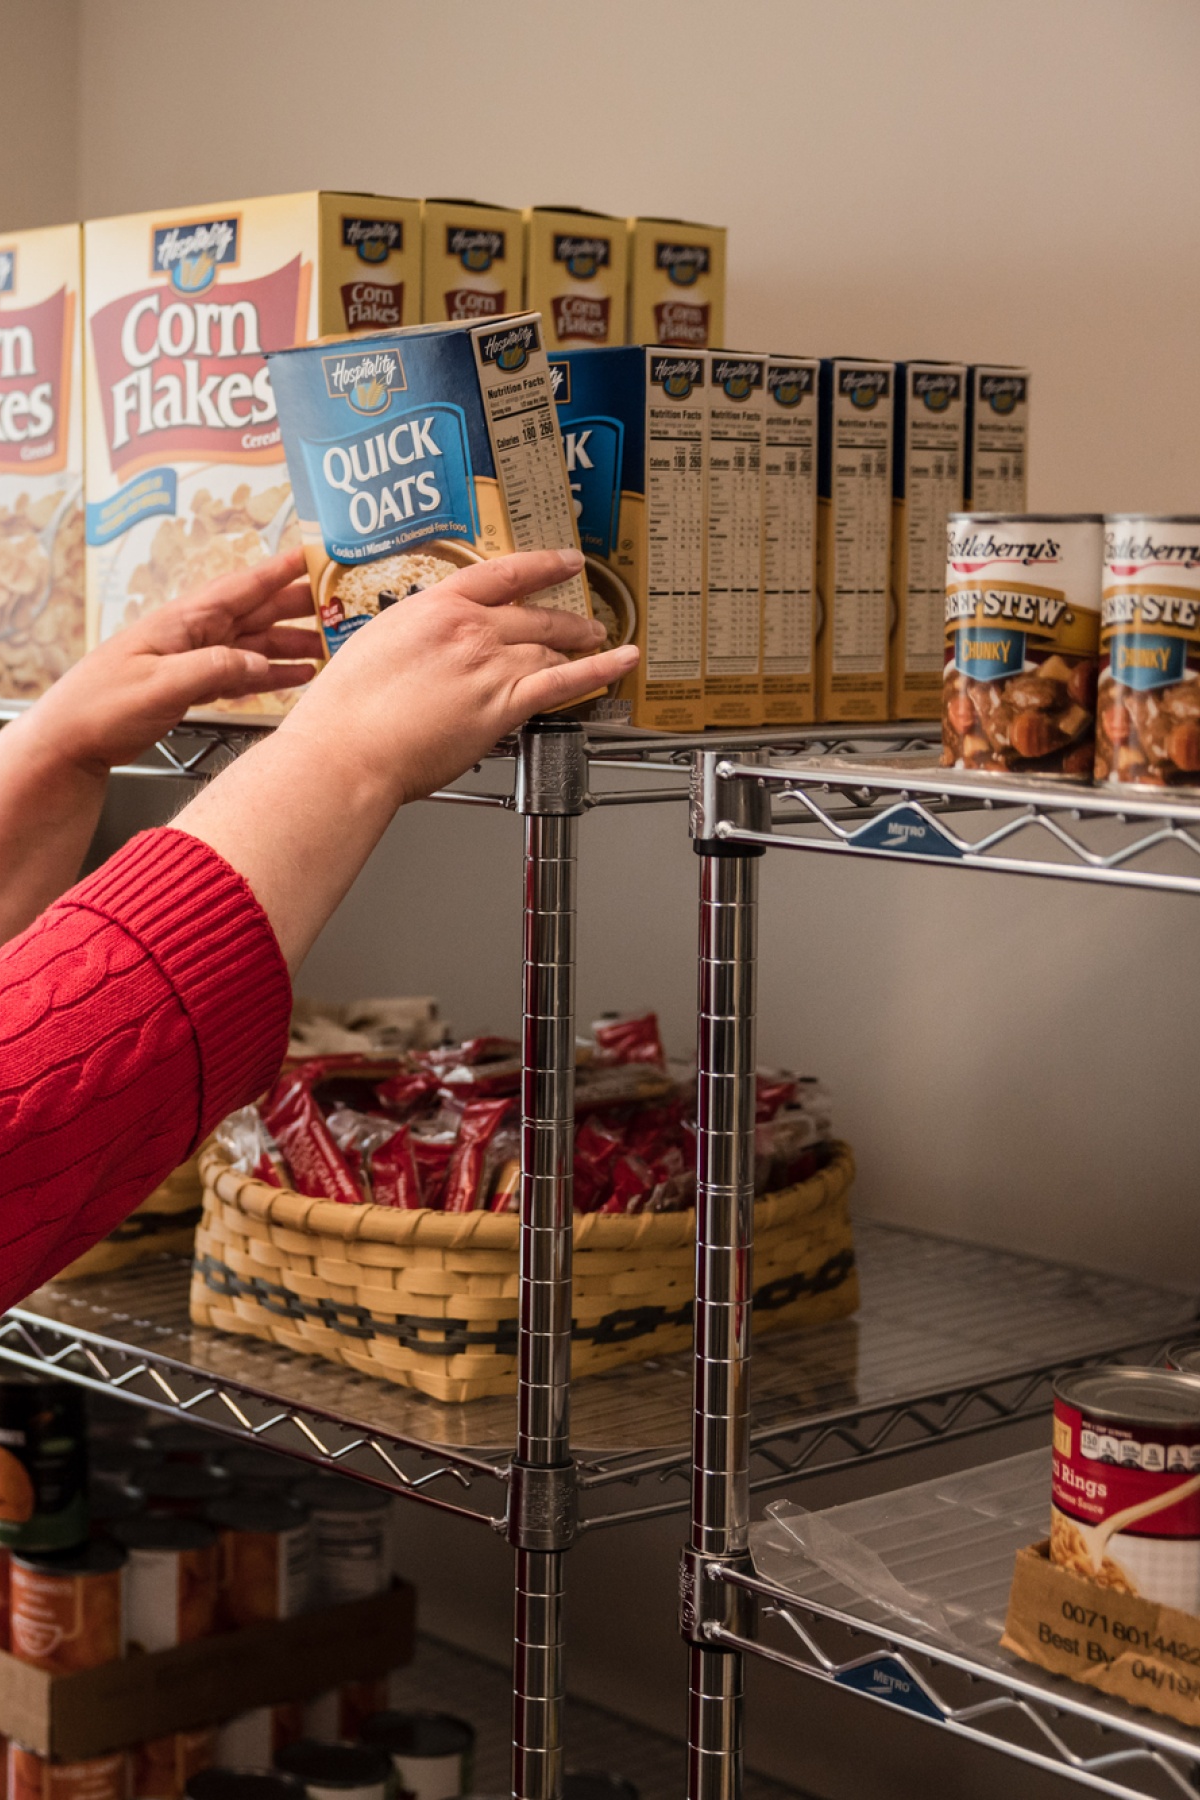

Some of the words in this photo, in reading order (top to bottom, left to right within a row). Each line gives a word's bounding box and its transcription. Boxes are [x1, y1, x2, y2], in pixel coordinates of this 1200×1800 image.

[158, 220, 233, 269] Hospitality
[352, 283, 393, 306] Corn
[455, 291, 496, 312] Corn
[349, 303, 399, 324] Flakes
[560, 298, 601, 319] Corn
[662, 305, 702, 323] Corn
[122, 294, 262, 368] Corn
[558, 315, 606, 336] Flakes
[484, 326, 534, 359] Hospitality
[331, 354, 396, 391] Hospitality
[655, 358, 699, 382] Hospitality
[488, 383, 522, 399] Nutrition
[522, 376, 545, 390] Facts
[111, 359, 277, 449] Flakes
[650, 409, 681, 420] Nutrition
[682, 409, 702, 421] Facts
[711, 409, 741, 420] Nutrition
[742, 410, 761, 422] Facts
[241, 427, 281, 449] Cereal
[497, 436, 520, 448] Calories
[522, 426, 537, 440] 180
[540, 420, 555, 436] 260
[323, 417, 442, 494] QUICK
[349, 471, 441, 534] OATS
[332, 544, 354, 558] Cooks
[354, 547, 363, 558] in
[366, 539, 391, 555] Minute
[983, 590, 1067, 627] STEW
[961, 639, 1012, 664] CHUNKY
[1117, 645, 1172, 672] CHUNKY
[1062, 1463, 1107, 1499] Rings
[1038, 1621, 1080, 1657] Best
